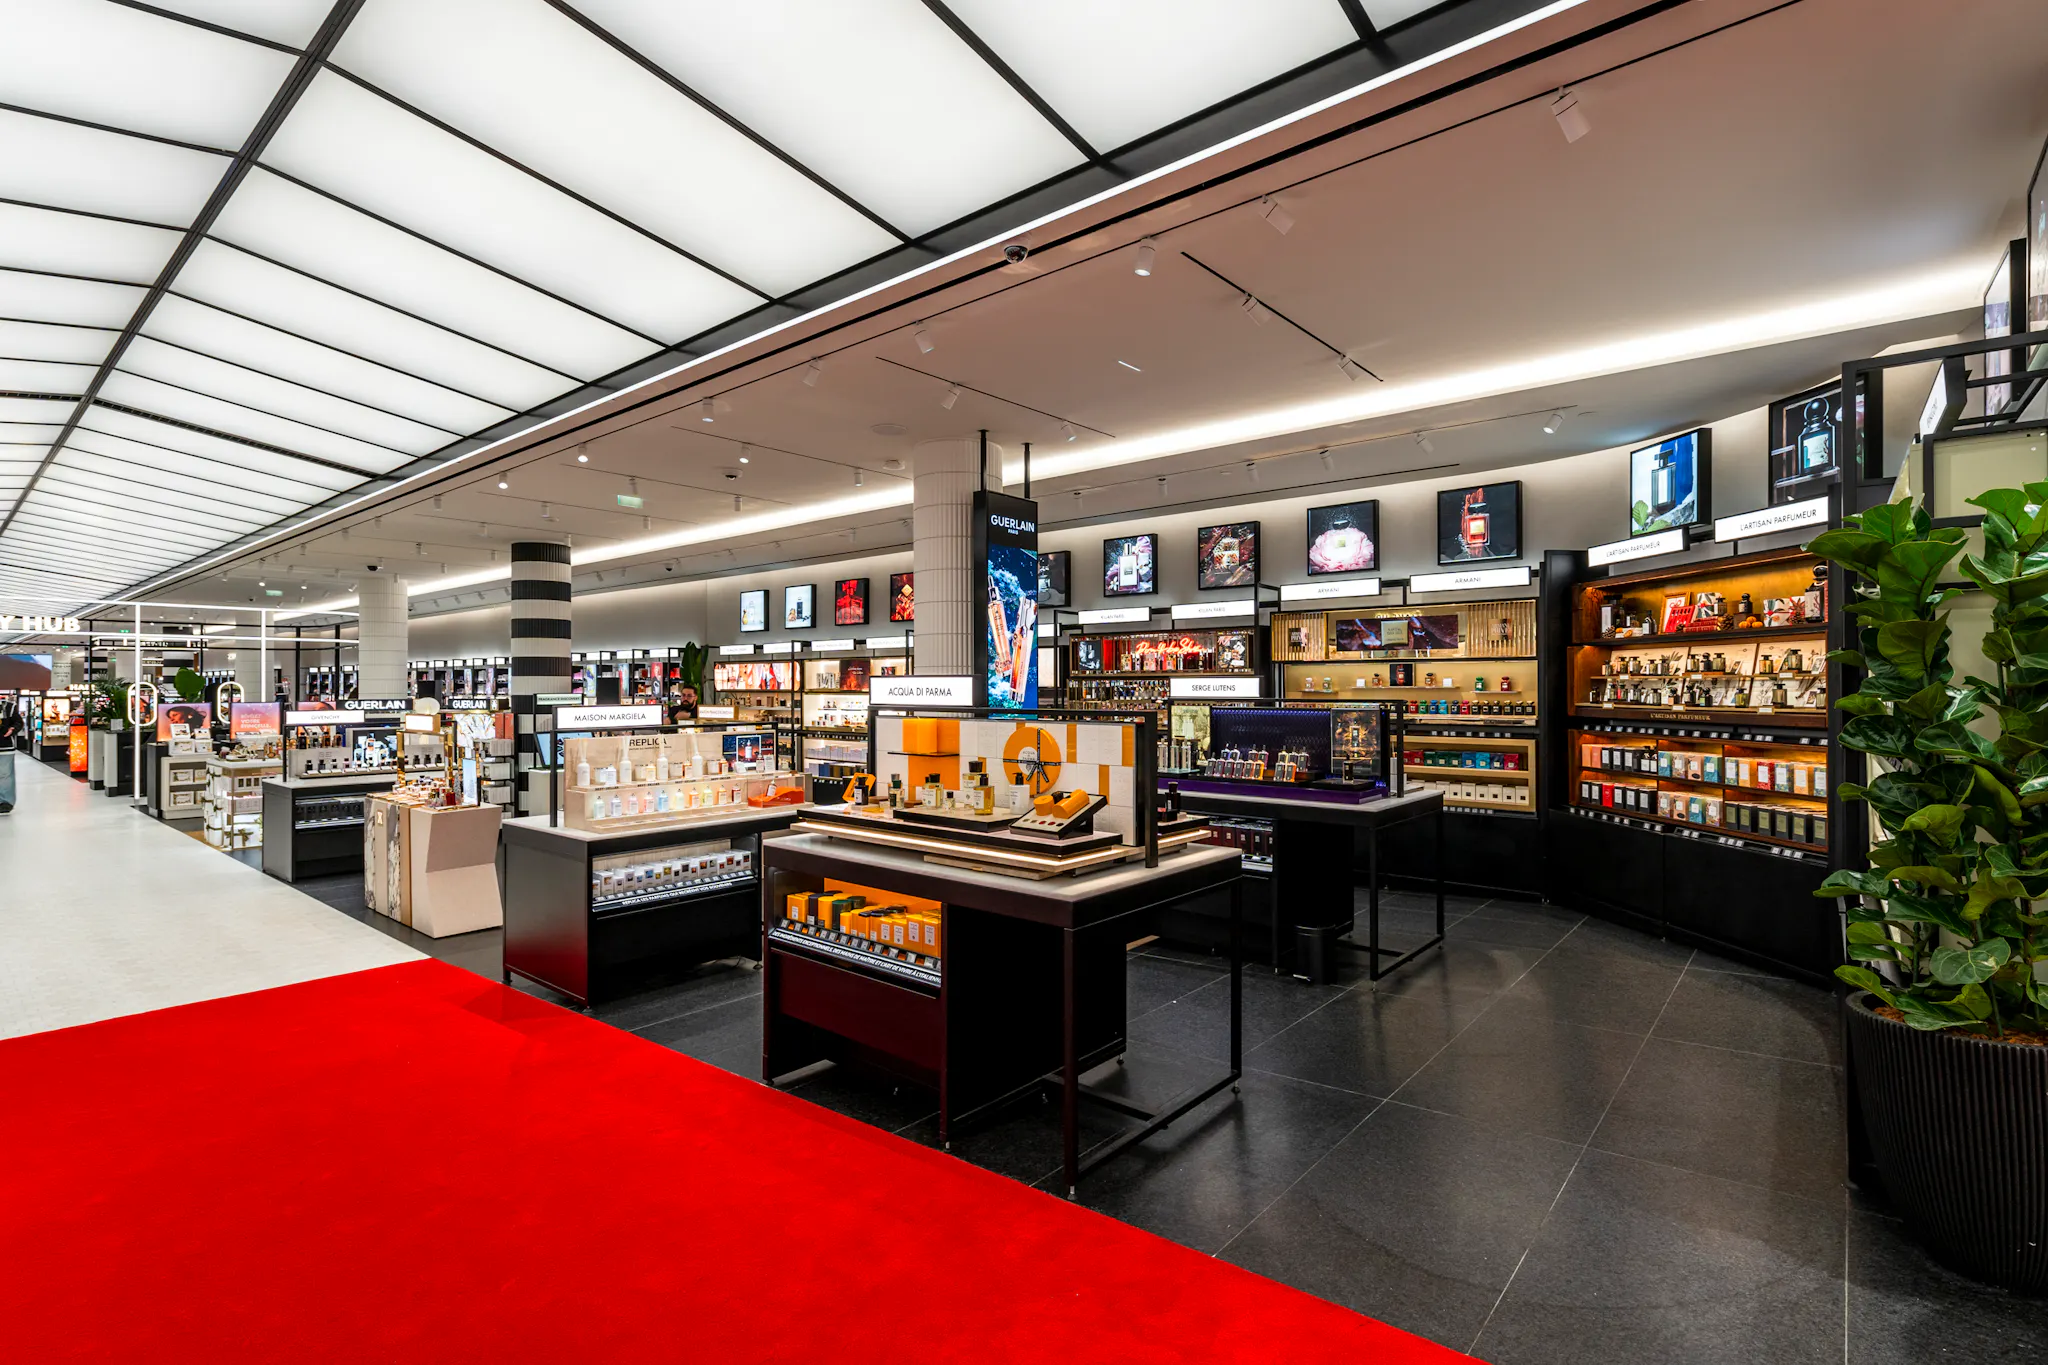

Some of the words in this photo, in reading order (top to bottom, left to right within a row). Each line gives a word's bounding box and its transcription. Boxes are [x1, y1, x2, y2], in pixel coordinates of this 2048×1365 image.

[990, 514, 1035, 533] GUERLAIN
[1739, 517, 1773, 532] L'ARTISAN
[1773, 508, 1817, 525] PARFUMEUR
[1605, 546, 1630, 558] L'ARTISAN
[1630, 540, 1661, 553] PARFUMEUR
[22, 616, 81, 631] HUB
[888, 687, 915, 696] ACQUA
[916, 687, 924, 696] DI
[925, 687, 952, 696] PARMA
[1191, 684, 1211, 692] SERGE
[1212, 684, 1236, 692] LUTENS
[345, 700, 406, 710] GUERLAIN
[452, 700, 487, 709] GUERLAIN
[574, 714, 607, 722] MAISON
[608, 712, 647, 721] MARGIELA
[648, 893, 670, 901] PARFUMS
[840, 950, 855, 959] MAINS
[898, 966, 914, 976] VIVRE
[916, 971, 941, 984] L'ITALIENN
